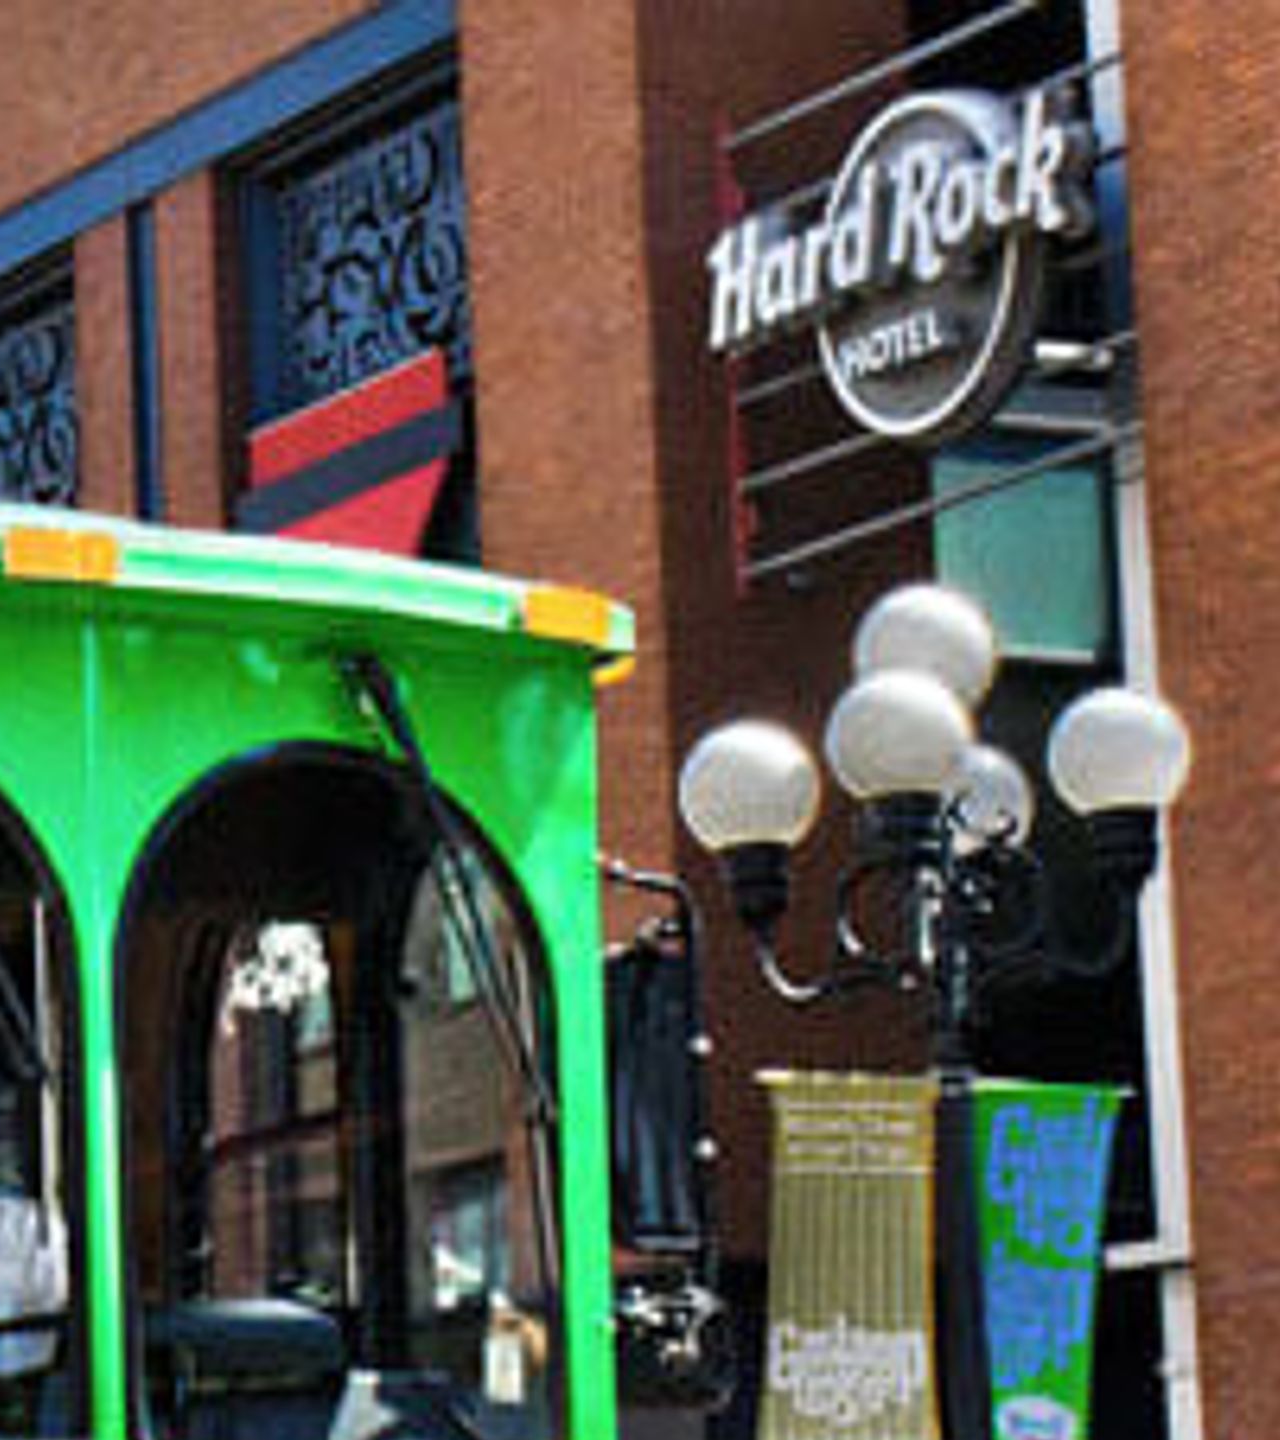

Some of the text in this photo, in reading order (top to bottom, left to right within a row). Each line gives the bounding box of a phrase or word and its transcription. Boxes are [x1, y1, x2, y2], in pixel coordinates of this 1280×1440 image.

[707, 90, 1068, 348] Hard Rock
[841, 308, 942, 380] HOTEL
